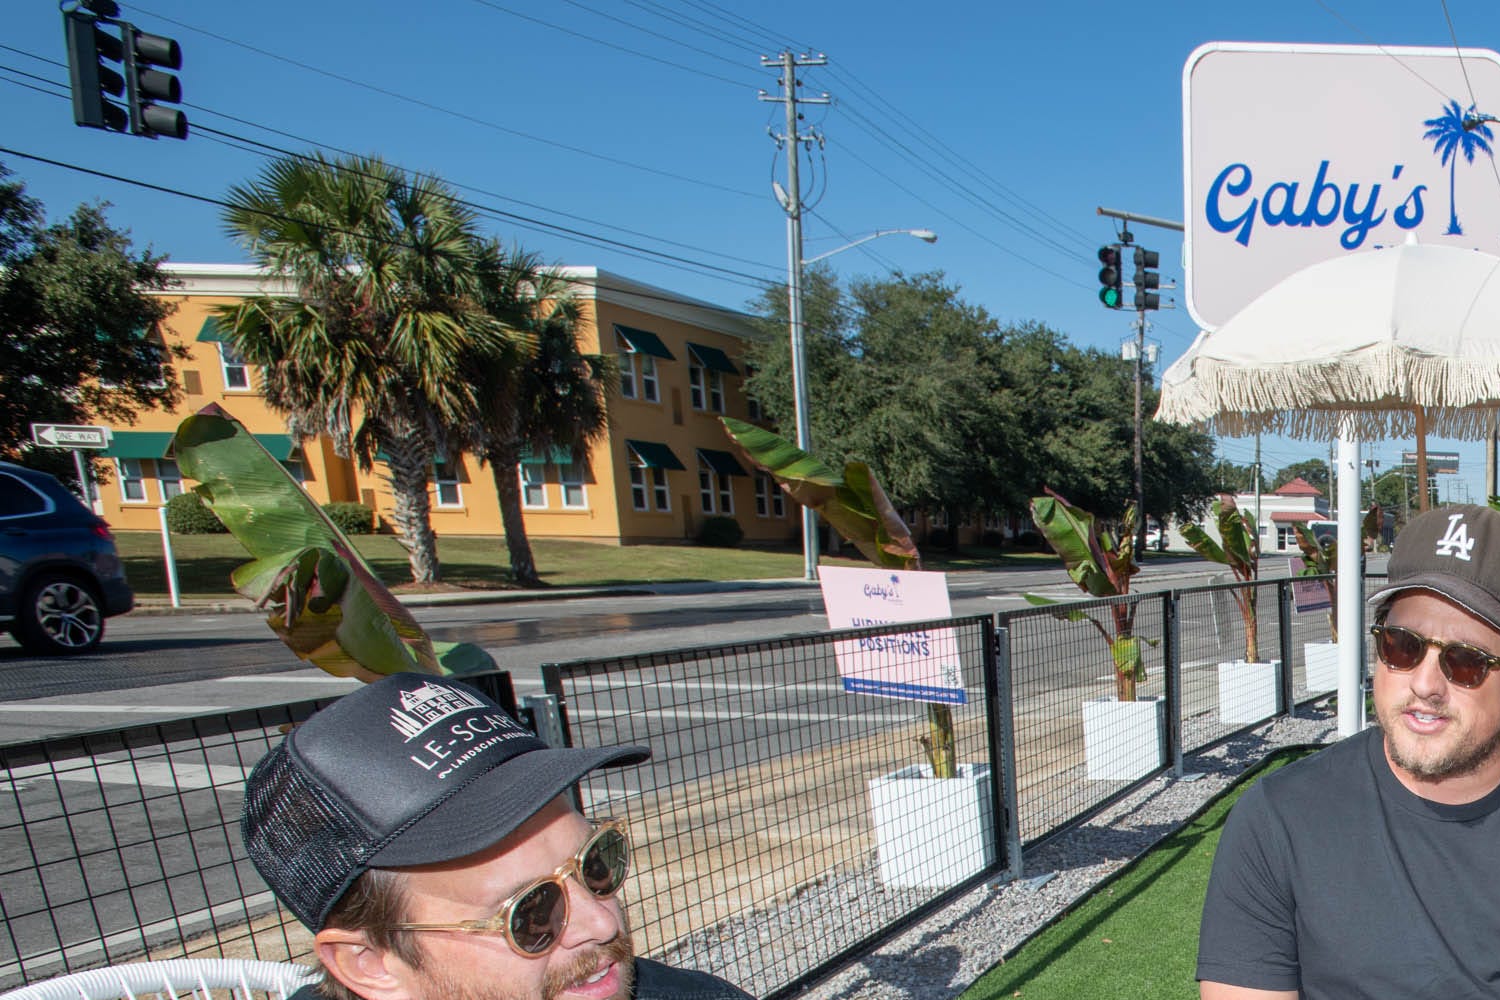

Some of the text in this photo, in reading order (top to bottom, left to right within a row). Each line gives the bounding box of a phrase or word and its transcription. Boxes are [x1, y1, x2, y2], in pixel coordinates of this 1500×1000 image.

[1205, 159, 1428, 250] Gaby's
[56, 431, 98, 441] ONE WAY
[1436, 513, 1475, 561] LA
[863, 583, 894, 600] Gaby's
[858, 635, 931, 657] POSITIONS
[450, 735, 503, 769] LANDSCAPE
